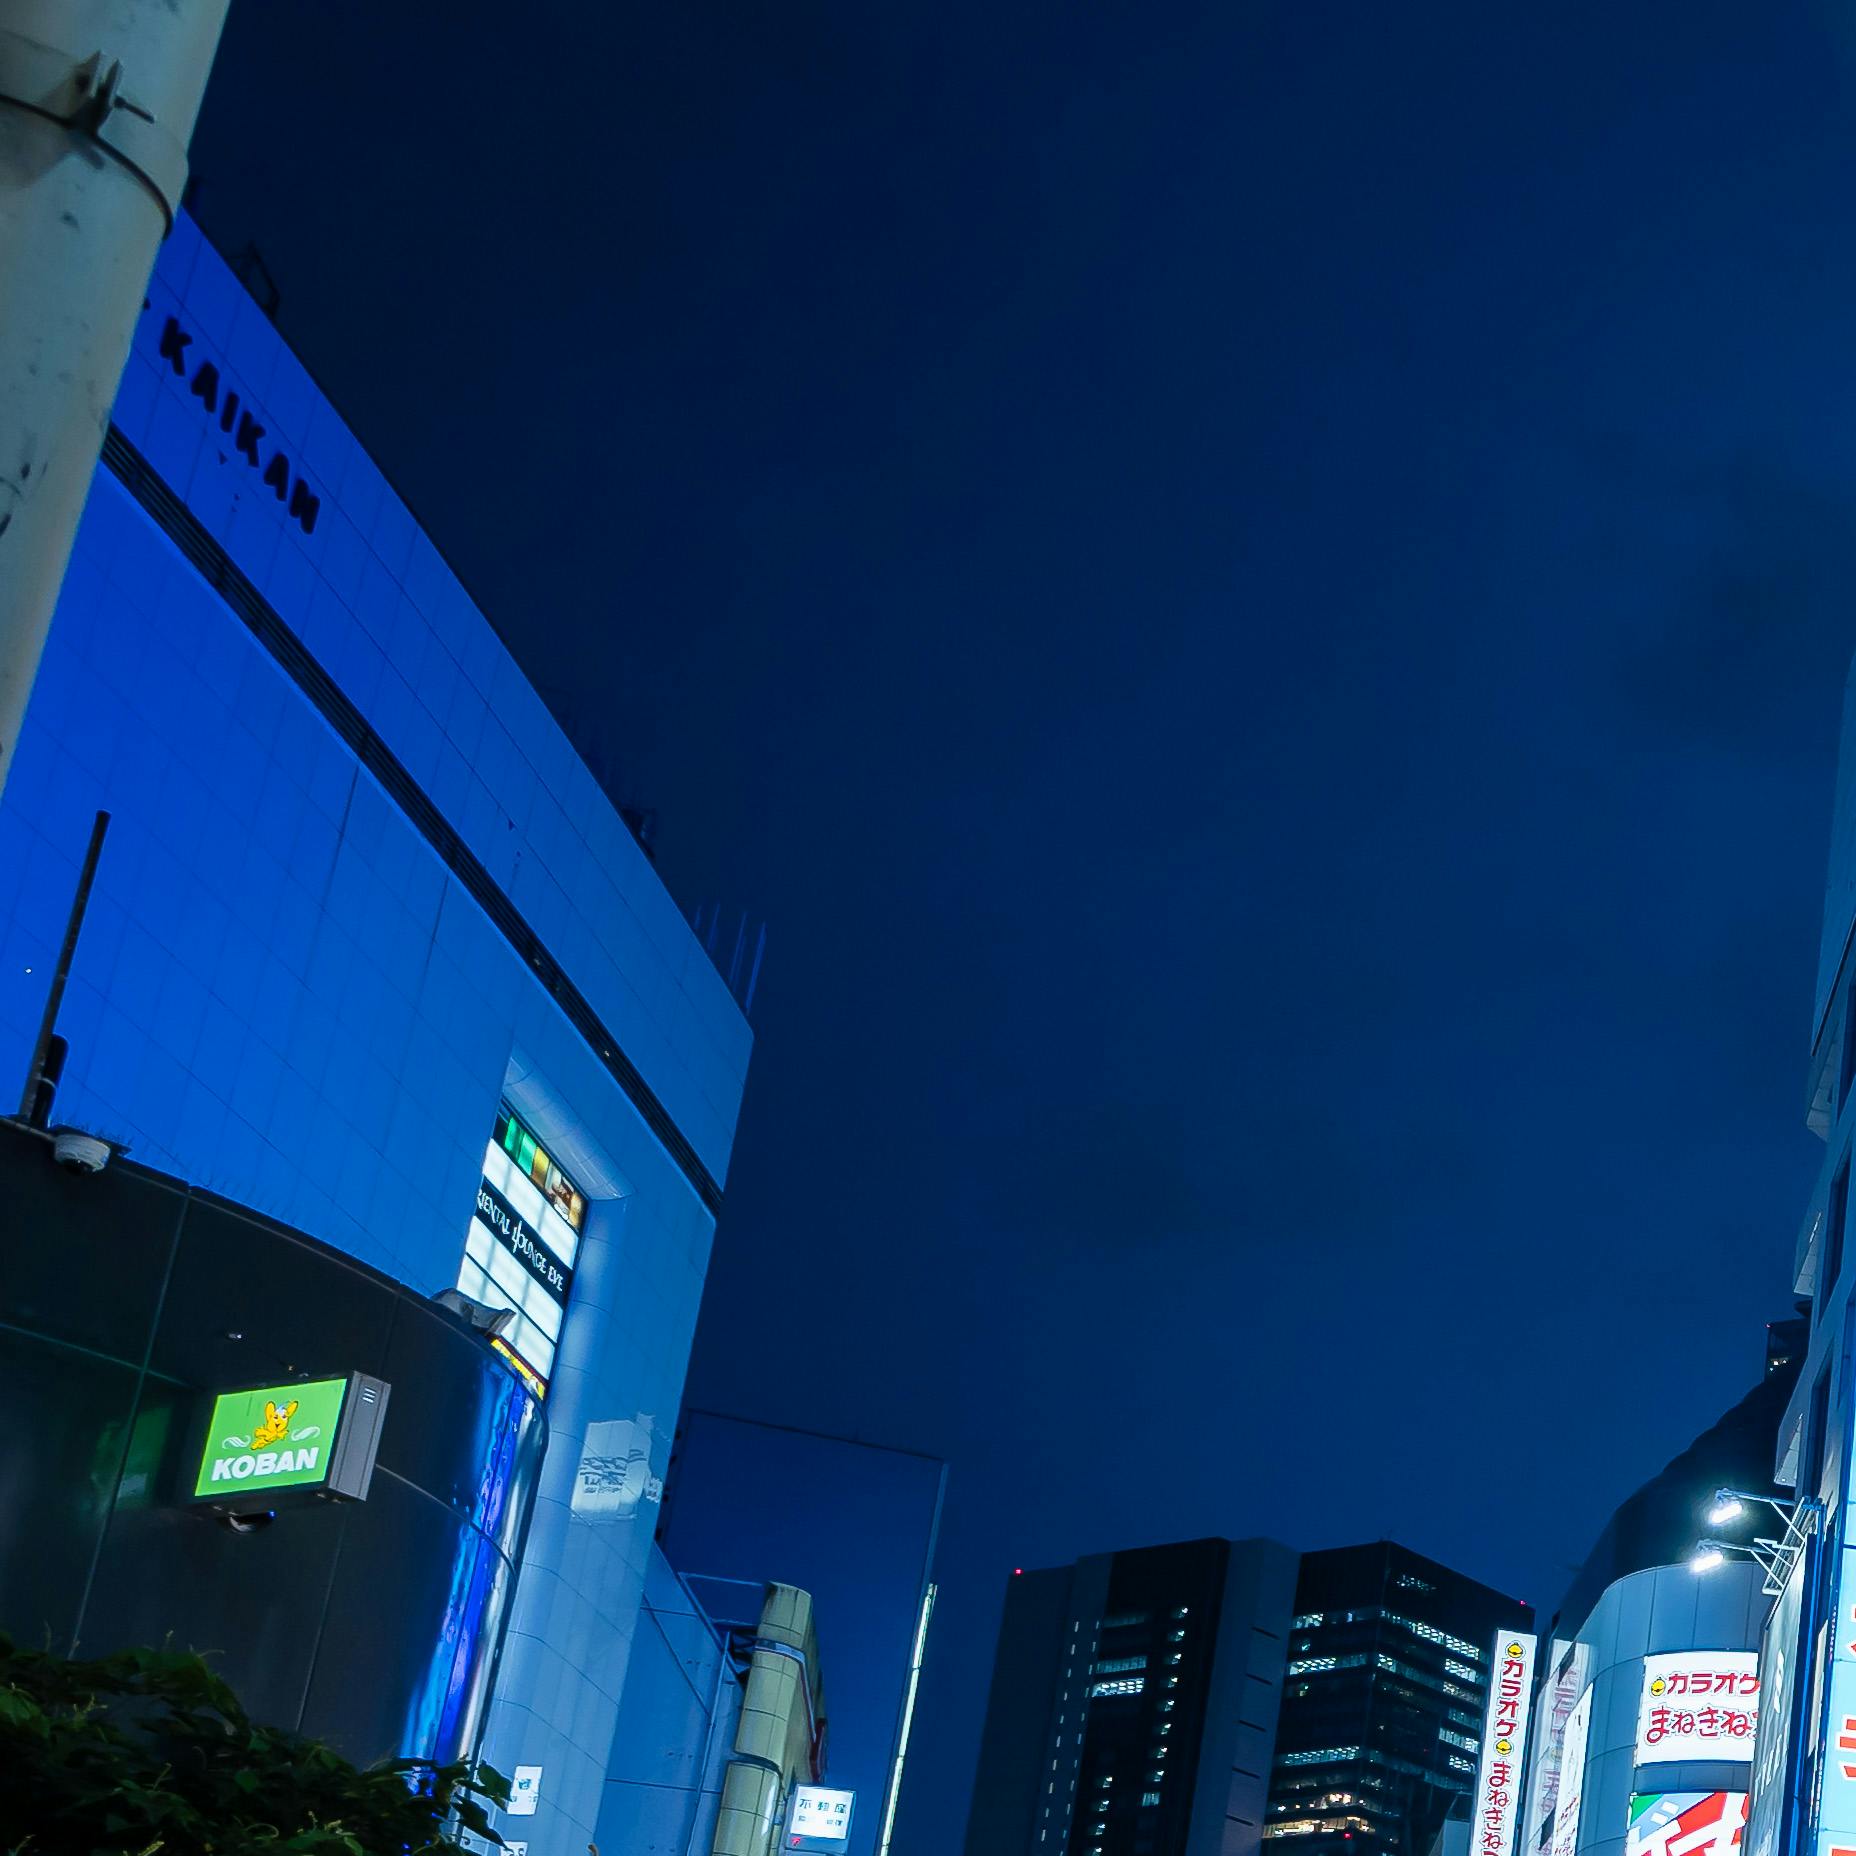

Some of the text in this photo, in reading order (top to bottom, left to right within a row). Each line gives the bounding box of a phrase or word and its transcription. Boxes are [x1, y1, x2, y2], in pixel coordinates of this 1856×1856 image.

[158, 316, 321, 535] KAIKAN
[511, 1219, 564, 1292] LOUNGE EVE
[211, 1446, 320, 1483] KOBAN
[1493, 1657, 1525, 1740] カラオケ
[1666, 1672, 1759, 1696] カラオケ
[1645, 1706, 1758, 1746] まねきね
